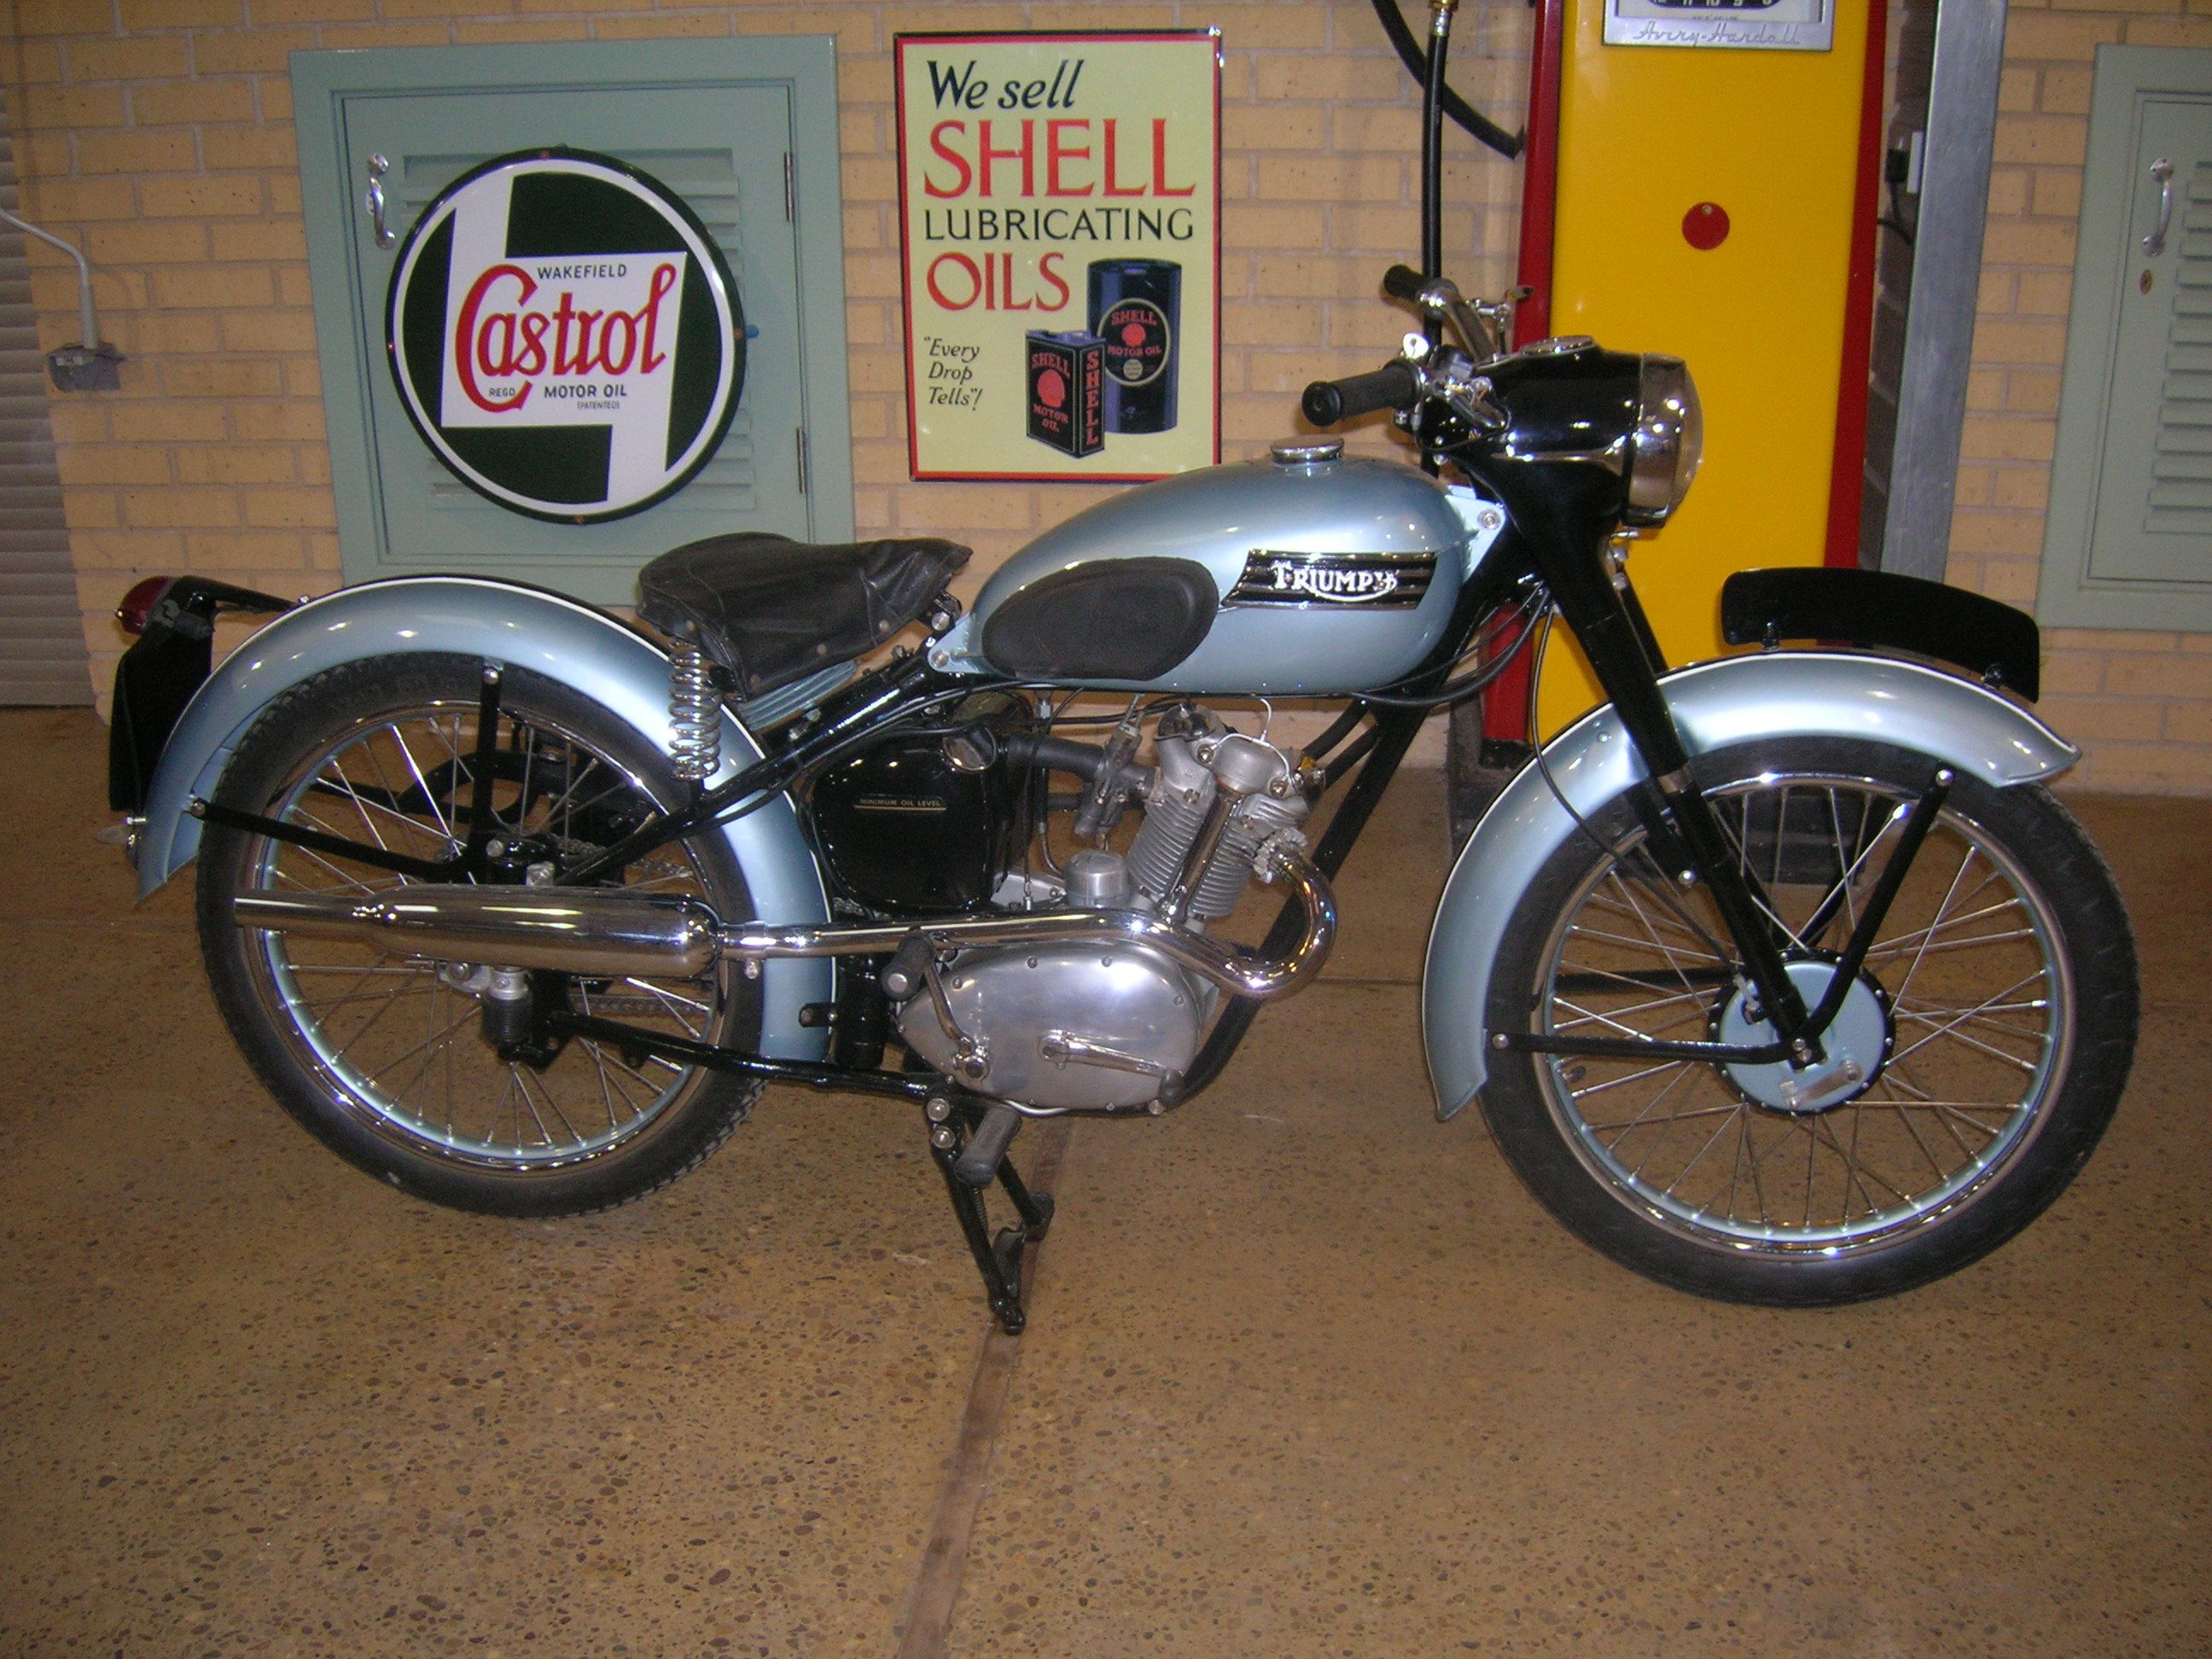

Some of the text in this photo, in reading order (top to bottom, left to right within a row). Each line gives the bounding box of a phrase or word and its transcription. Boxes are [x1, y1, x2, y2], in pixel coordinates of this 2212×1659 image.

[927, 59, 1085, 110] We sell
[923, 118, 1196, 199] SHELL
[924, 207, 1194, 241] LUBRICATING
[537, 264, 627, 280] WAKEFIELD
[927, 252, 1070, 312] OILS
[1111, 310, 1157, 327] SHELL
[455, 262, 677, 412] Castrol
[928, 361, 973, 385] Drop
[1031, 352, 1070, 380] SHELL
[488, 387, 516, 397] REGD
[544, 384, 627, 399] MOTOR OIL
[1086, 350, 1100, 445] SHELL
[1270, 559, 1400, 600] TRIUMPH
